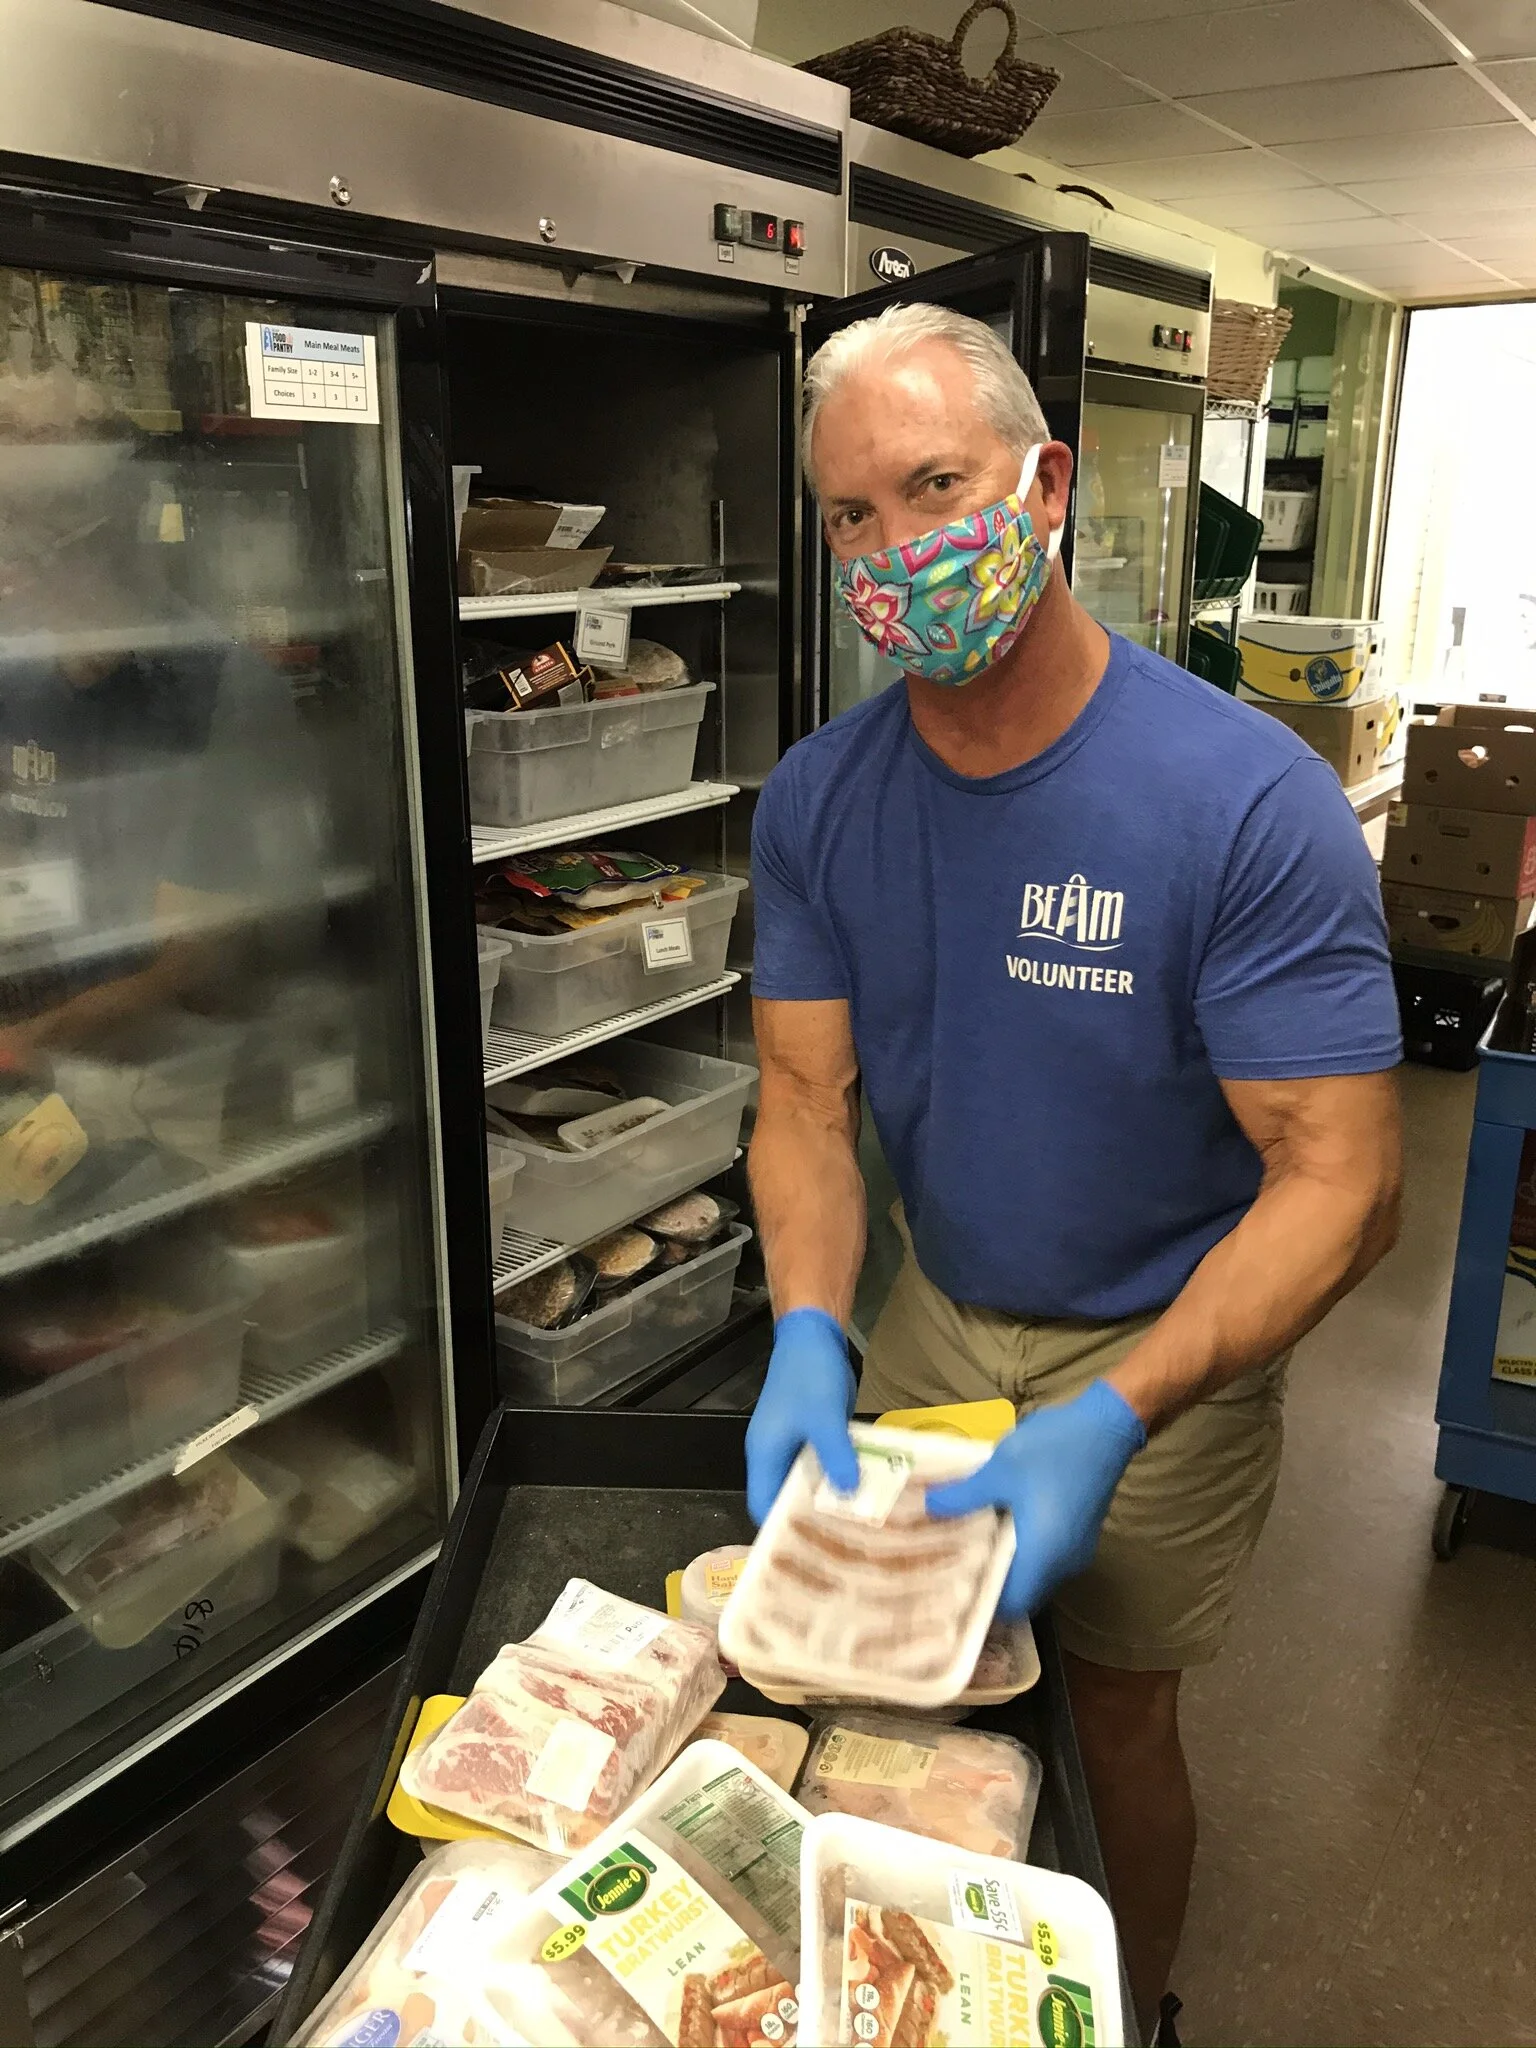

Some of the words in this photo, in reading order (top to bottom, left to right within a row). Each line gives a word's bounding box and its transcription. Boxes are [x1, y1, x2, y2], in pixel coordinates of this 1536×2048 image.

[767, 223, 774, 239] 6
[272, 332, 286, 343] FOOD
[273, 342, 293, 354] PANTRY
[304, 340, 321, 349] Main
[323, 342, 339, 352] Meal
[340, 344, 360, 353] Meats
[267, 365, 286, 375] Family
[273, 389, 295, 398] Choices
[1006, 955, 1133, 995] VOLUNTEER
[597, 1868, 642, 1909] Jennie-O
[984, 1877, 1001, 1907] Save
[598, 1877, 693, 1959] TURKEY
[546, 1925, 586, 1959] $5.99
[615, 1895, 709, 1978] BRATWURST
[1037, 1922, 1054, 1966] $5.99
[667, 1941, 706, 1977] LEAN
[960, 1972, 972, 2025] LEAN
